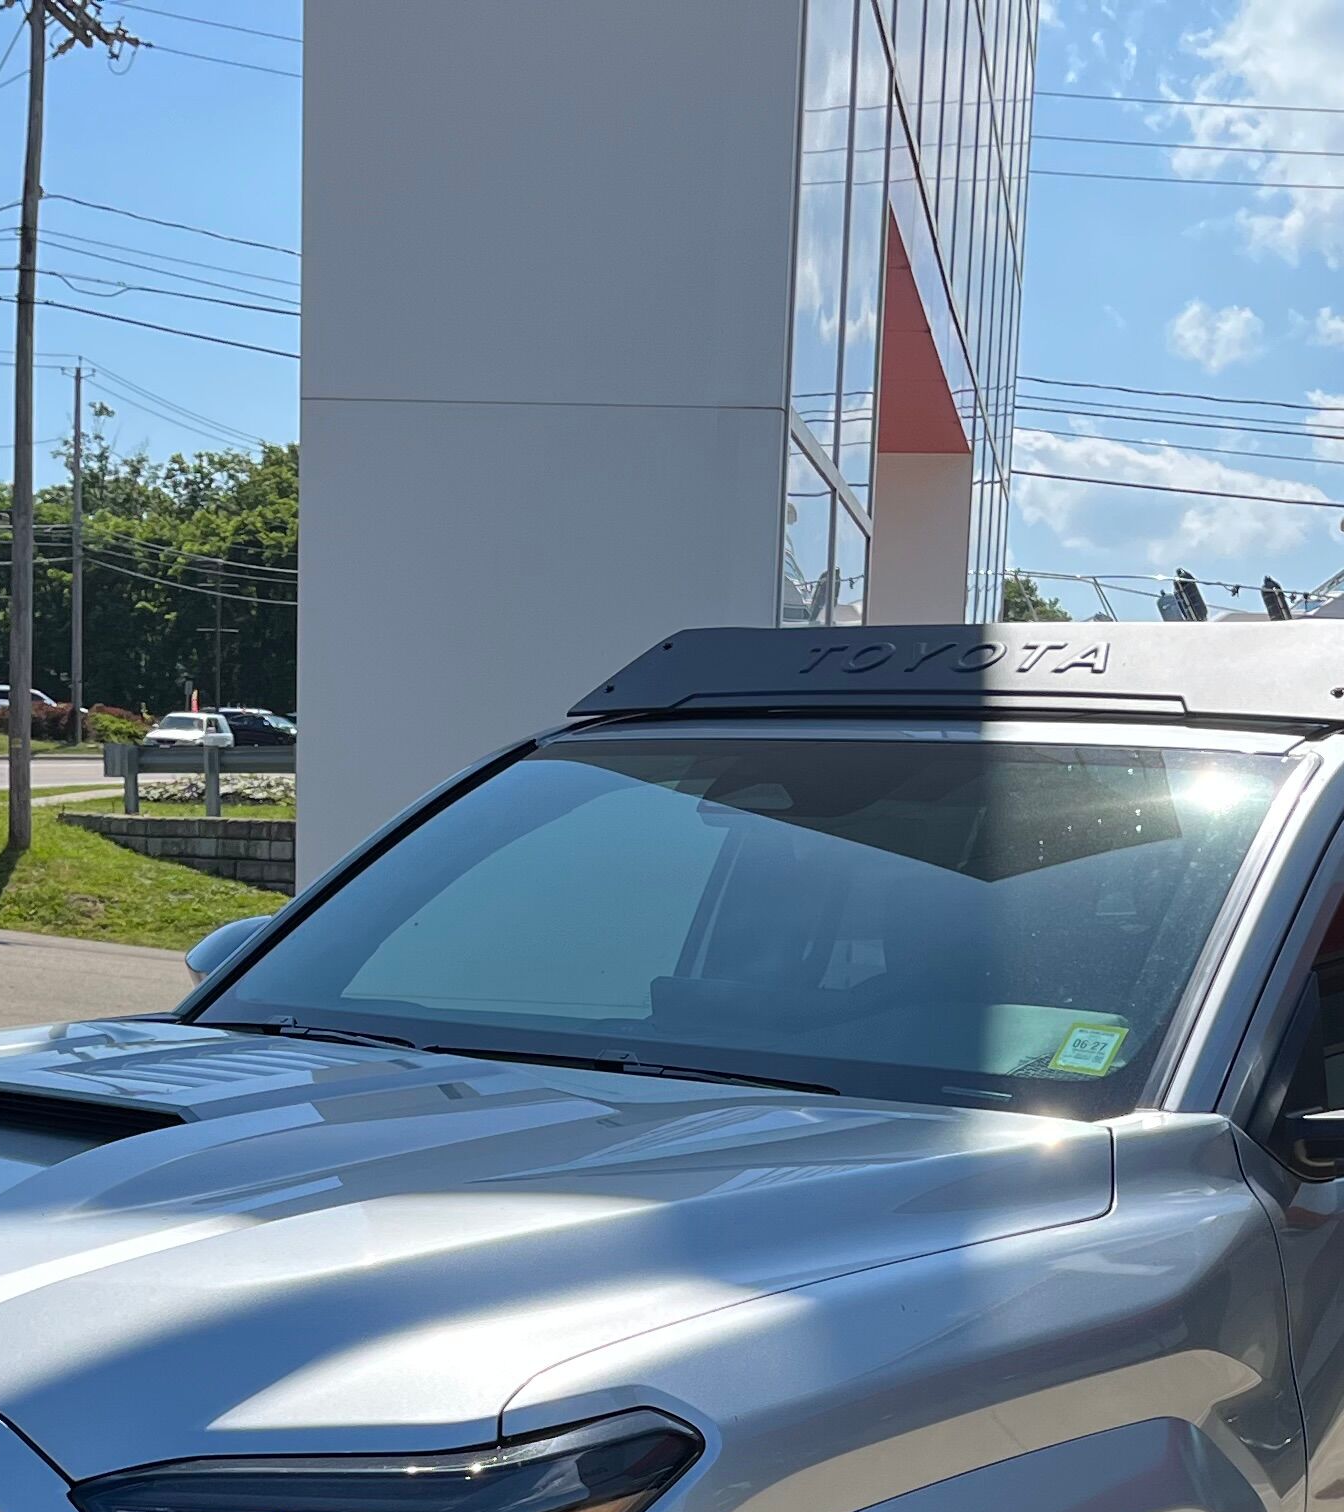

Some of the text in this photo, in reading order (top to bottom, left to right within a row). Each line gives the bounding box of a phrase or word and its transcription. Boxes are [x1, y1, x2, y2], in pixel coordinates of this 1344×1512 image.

[799, 641, 1111, 674] TOYOTA
[1072, 1038, 1109, 1053] 06 27
